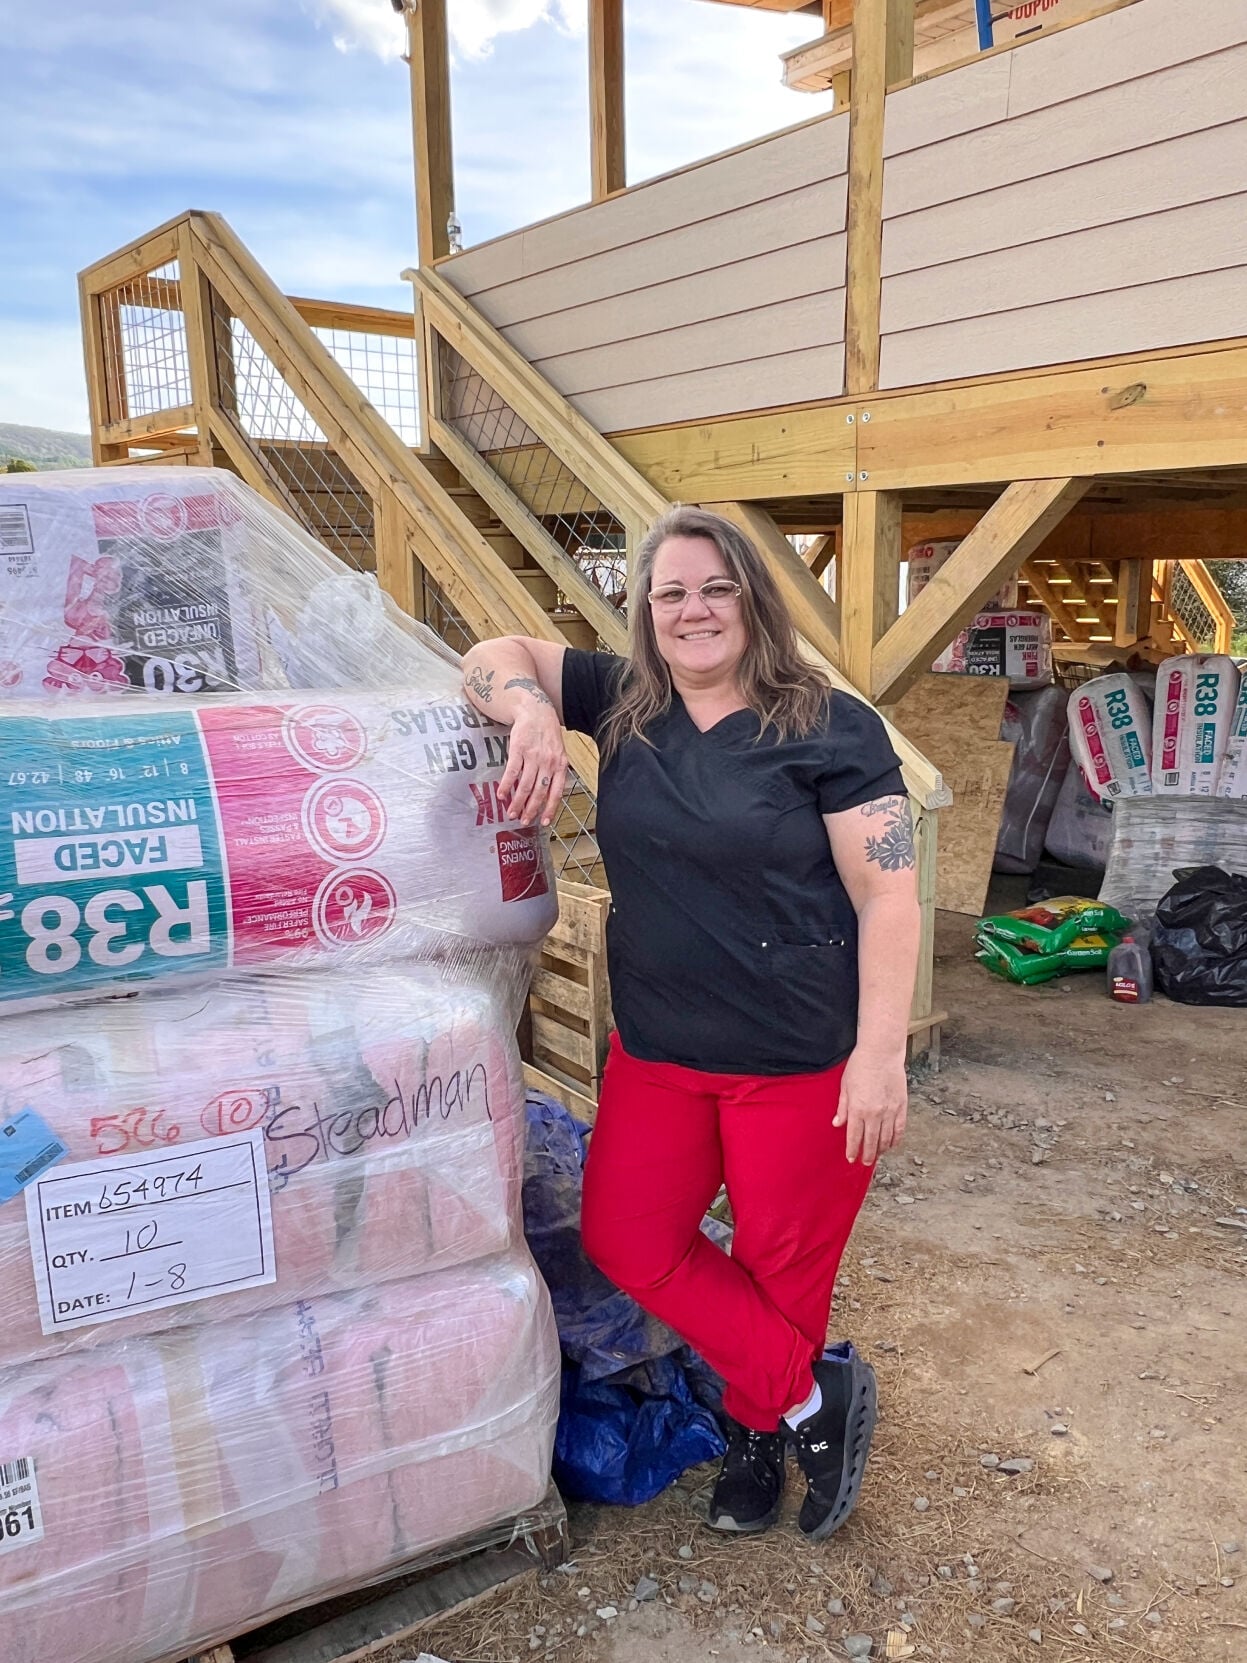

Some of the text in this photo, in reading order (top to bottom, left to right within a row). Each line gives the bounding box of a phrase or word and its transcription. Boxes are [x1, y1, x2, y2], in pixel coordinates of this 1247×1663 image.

[133, 604, 218, 625] INSULATION
[143, 622, 217, 647] UNFACED
[1104, 688, 1133, 730] R38
[1194, 673, 1220, 717] R38
[423, 738, 478, 776] GEN
[1128, 737, 1142, 760] FACED
[1203, 730, 1214, 756] FACED
[11, 798, 197, 834] INSULATION
[54, 835, 168, 872] FACED
[501, 849, 535, 867] OWENS
[21, 879, 211, 974] R38
[265, 1062, 493, 1176] Steadman
[45, 1163, 203, 1221] ITEM 654974
[51, 1219, 158, 1269] QTY. 10
[57, 1293, 111, 1314] DATE:
